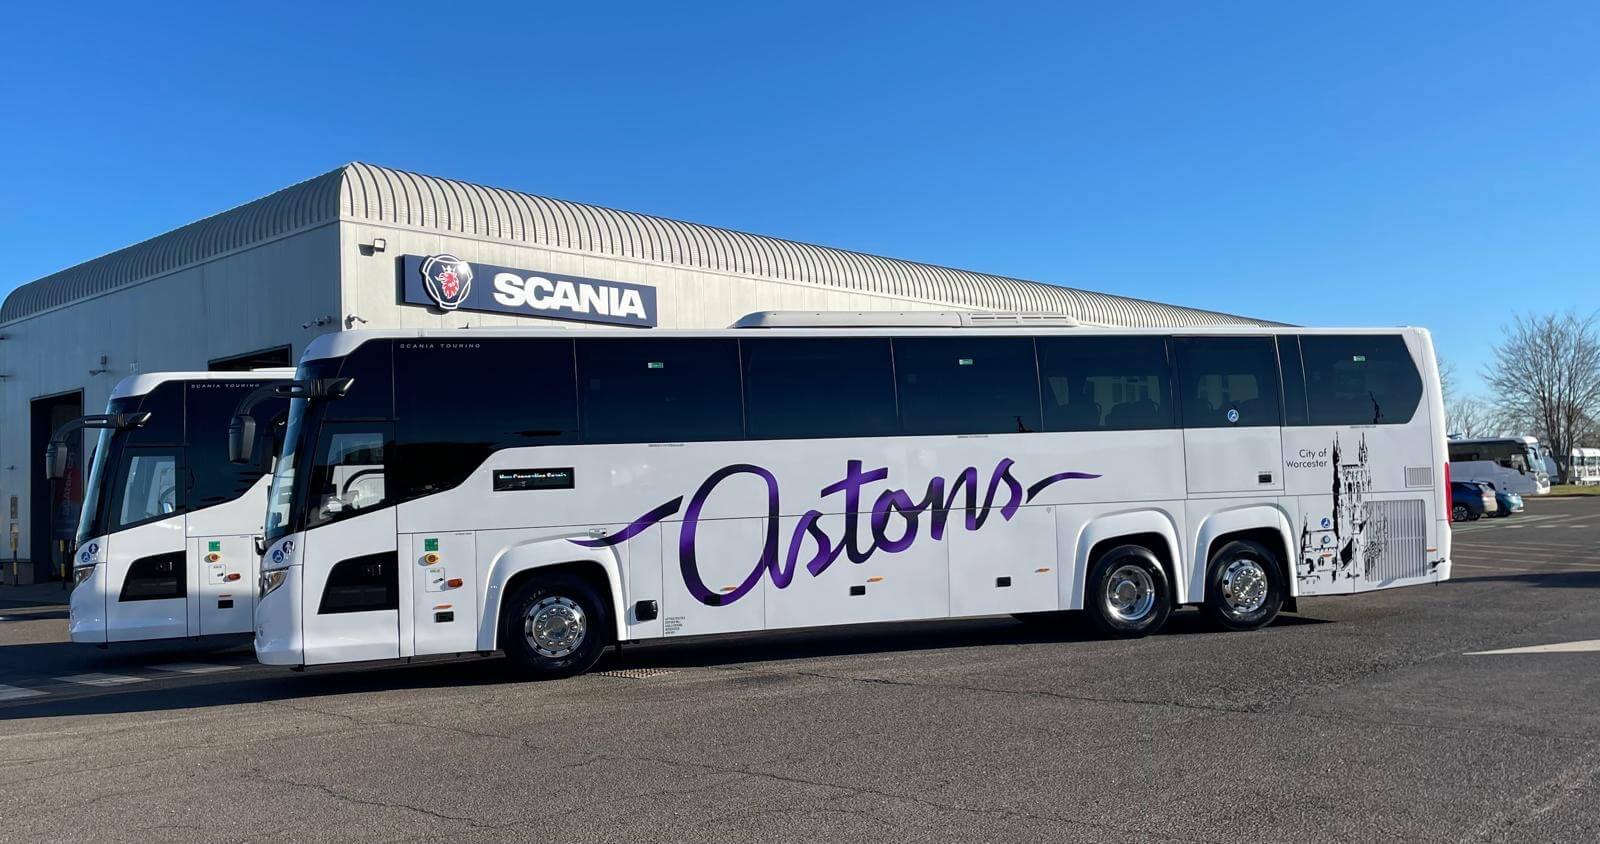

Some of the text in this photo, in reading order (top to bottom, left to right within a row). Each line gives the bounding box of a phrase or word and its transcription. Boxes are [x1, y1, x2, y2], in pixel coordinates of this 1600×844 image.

[493, 272, 647, 319] SCANIA
[1299, 448, 1327, 460] City of
[1285, 460, 1327, 468] Worcester
